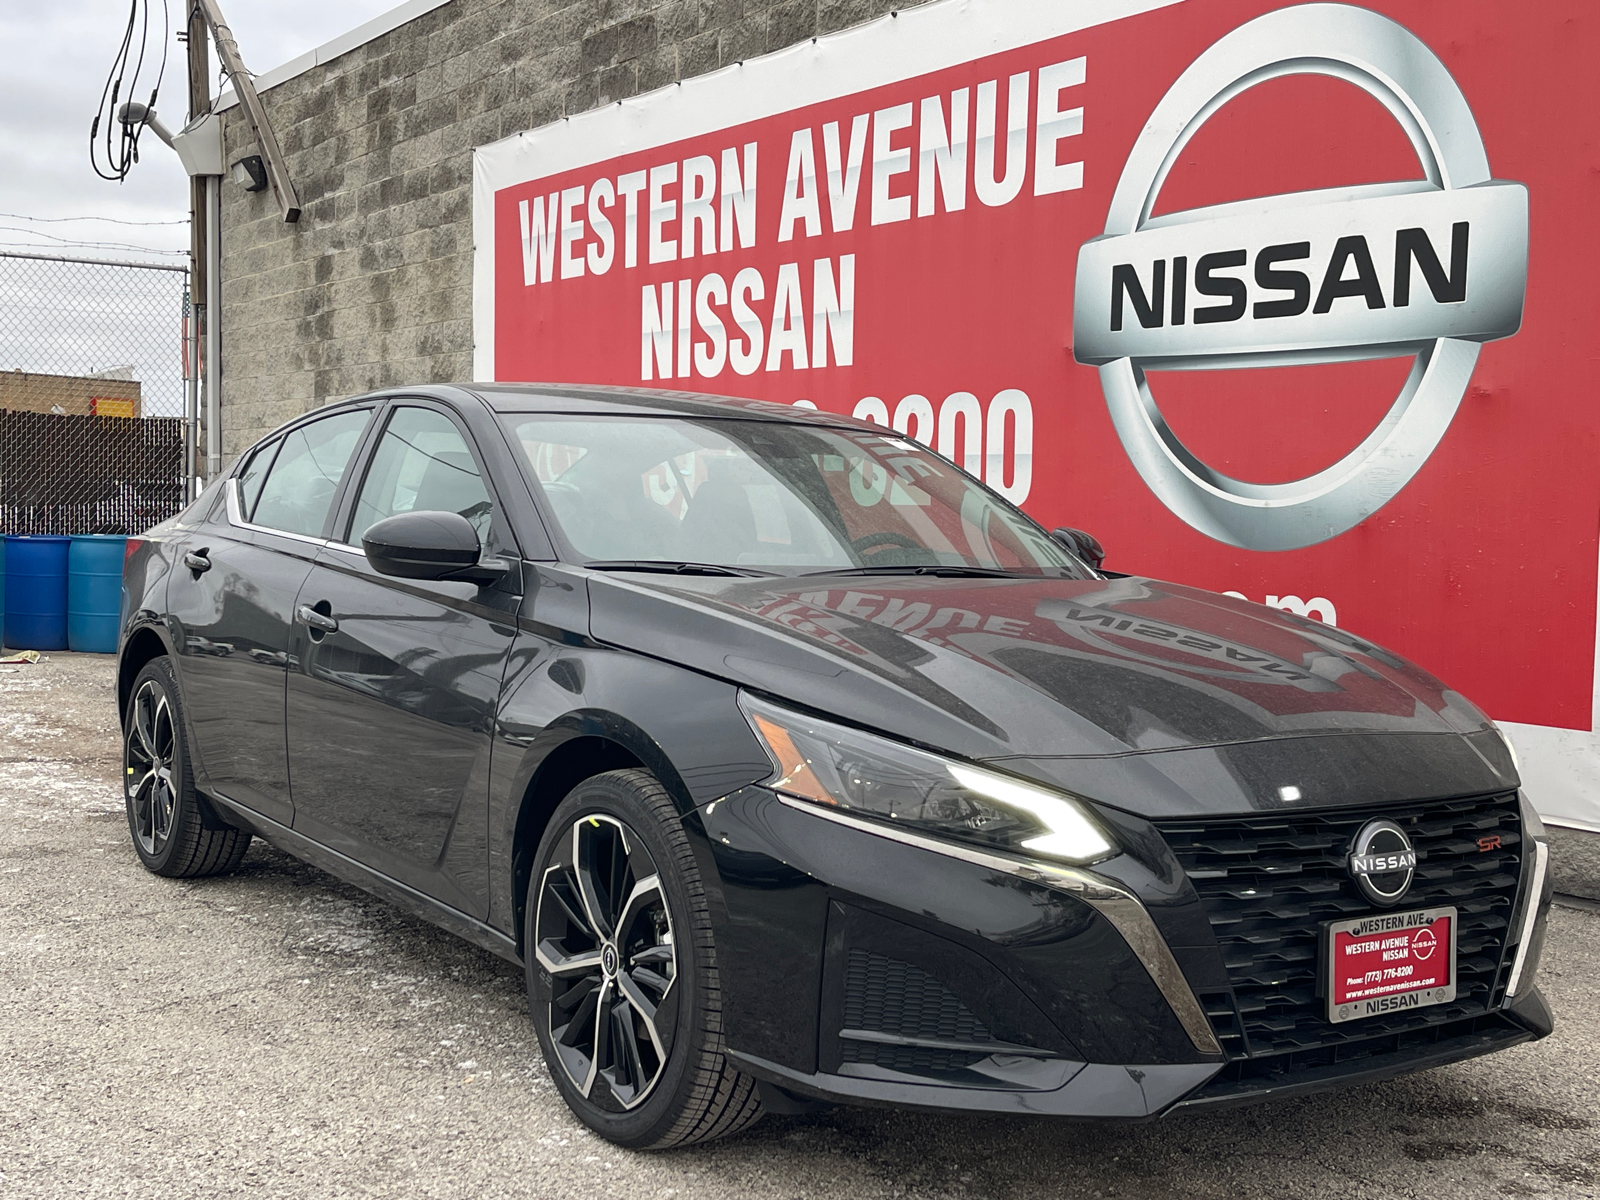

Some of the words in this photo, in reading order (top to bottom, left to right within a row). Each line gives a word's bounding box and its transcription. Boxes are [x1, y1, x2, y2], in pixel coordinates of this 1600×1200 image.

[519, 141, 758, 287] WESTERN
[777, 55, 1087, 243] AVENUE
[1110, 221, 1470, 332] NISSAN
[641, 253, 855, 381] NISSAN
[1477, 835, 1502, 853] SR
[1353, 852, 1416, 872] NISSAN
[1360, 916, 1405, 933] WESTERN
[1345, 940, 1380, 955] WESTERN
[1381, 936, 1409, 950] AVENUE
[1382, 948, 1409, 961] NISSAN
[1411, 940, 1437, 949] NISSAN
[1346, 977, 1363, 986] Phone:
[1364, 969, 1382, 985] (773)
[1383, 965, 1413, 980] 776-8200
[1346, 977, 1435, 999] www.westernavenissan.com
[1366, 993, 1419, 1014] NISSAN
